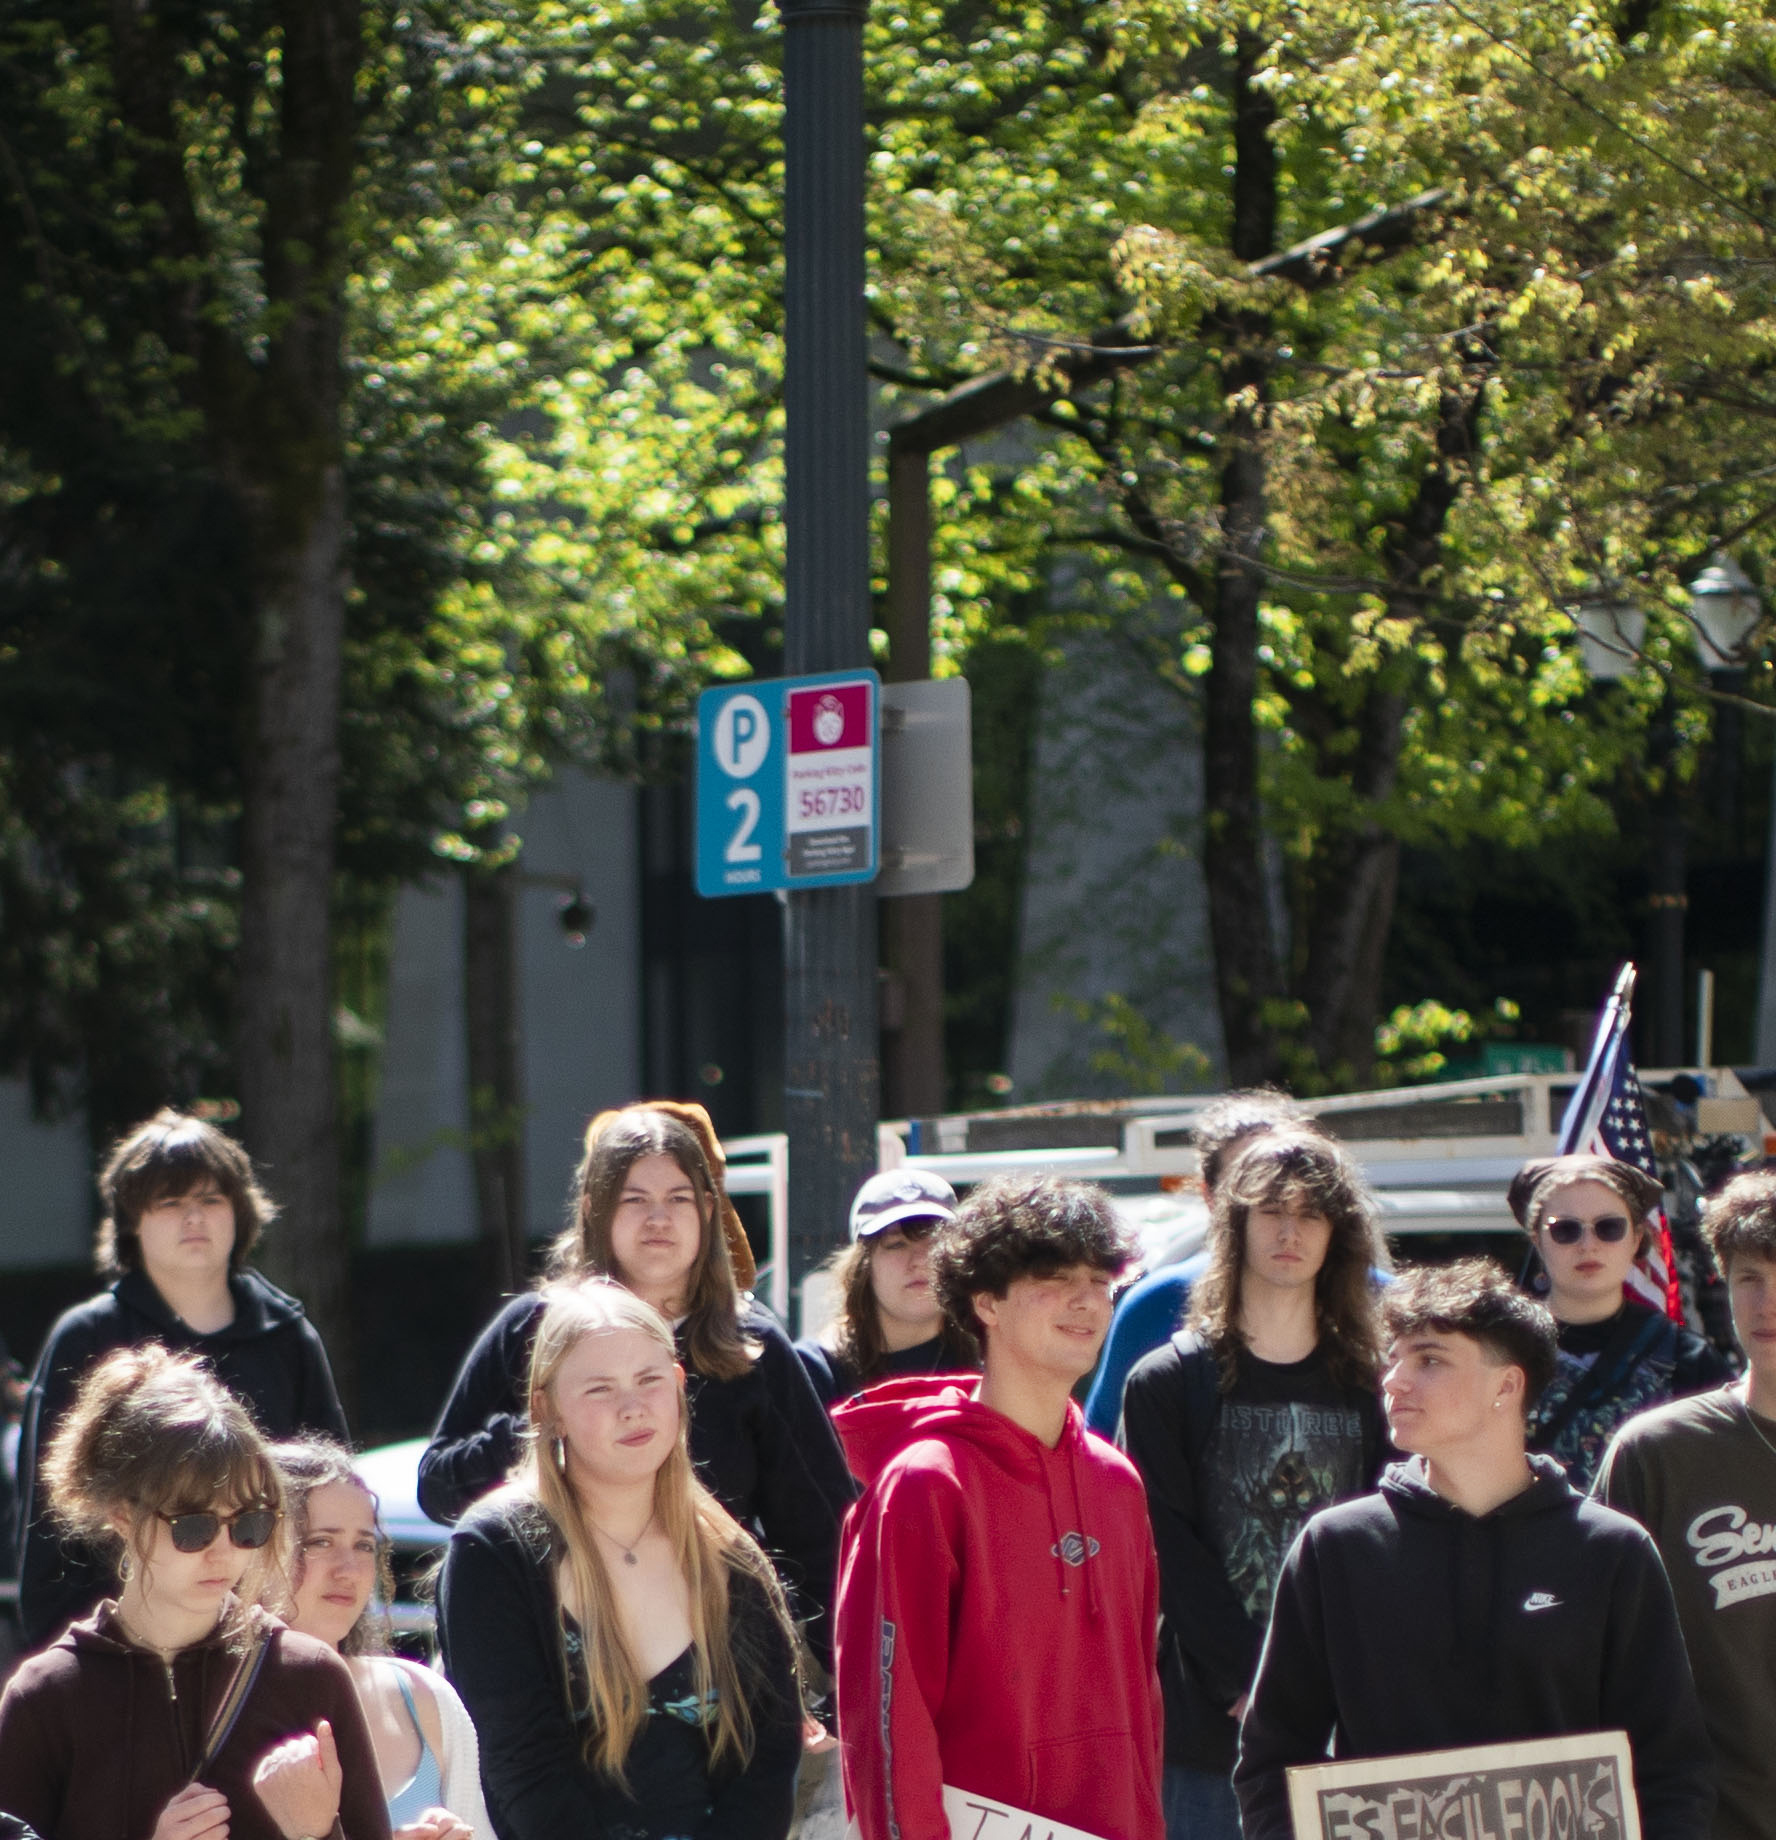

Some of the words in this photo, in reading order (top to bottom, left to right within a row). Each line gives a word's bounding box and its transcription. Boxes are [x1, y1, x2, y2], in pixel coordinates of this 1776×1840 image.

[731, 708, 757, 765] P
[800, 786, 865, 818] 56730
[726, 788, 762, 863] 2
[1220, 1403, 1362, 1438] ISTURBE
